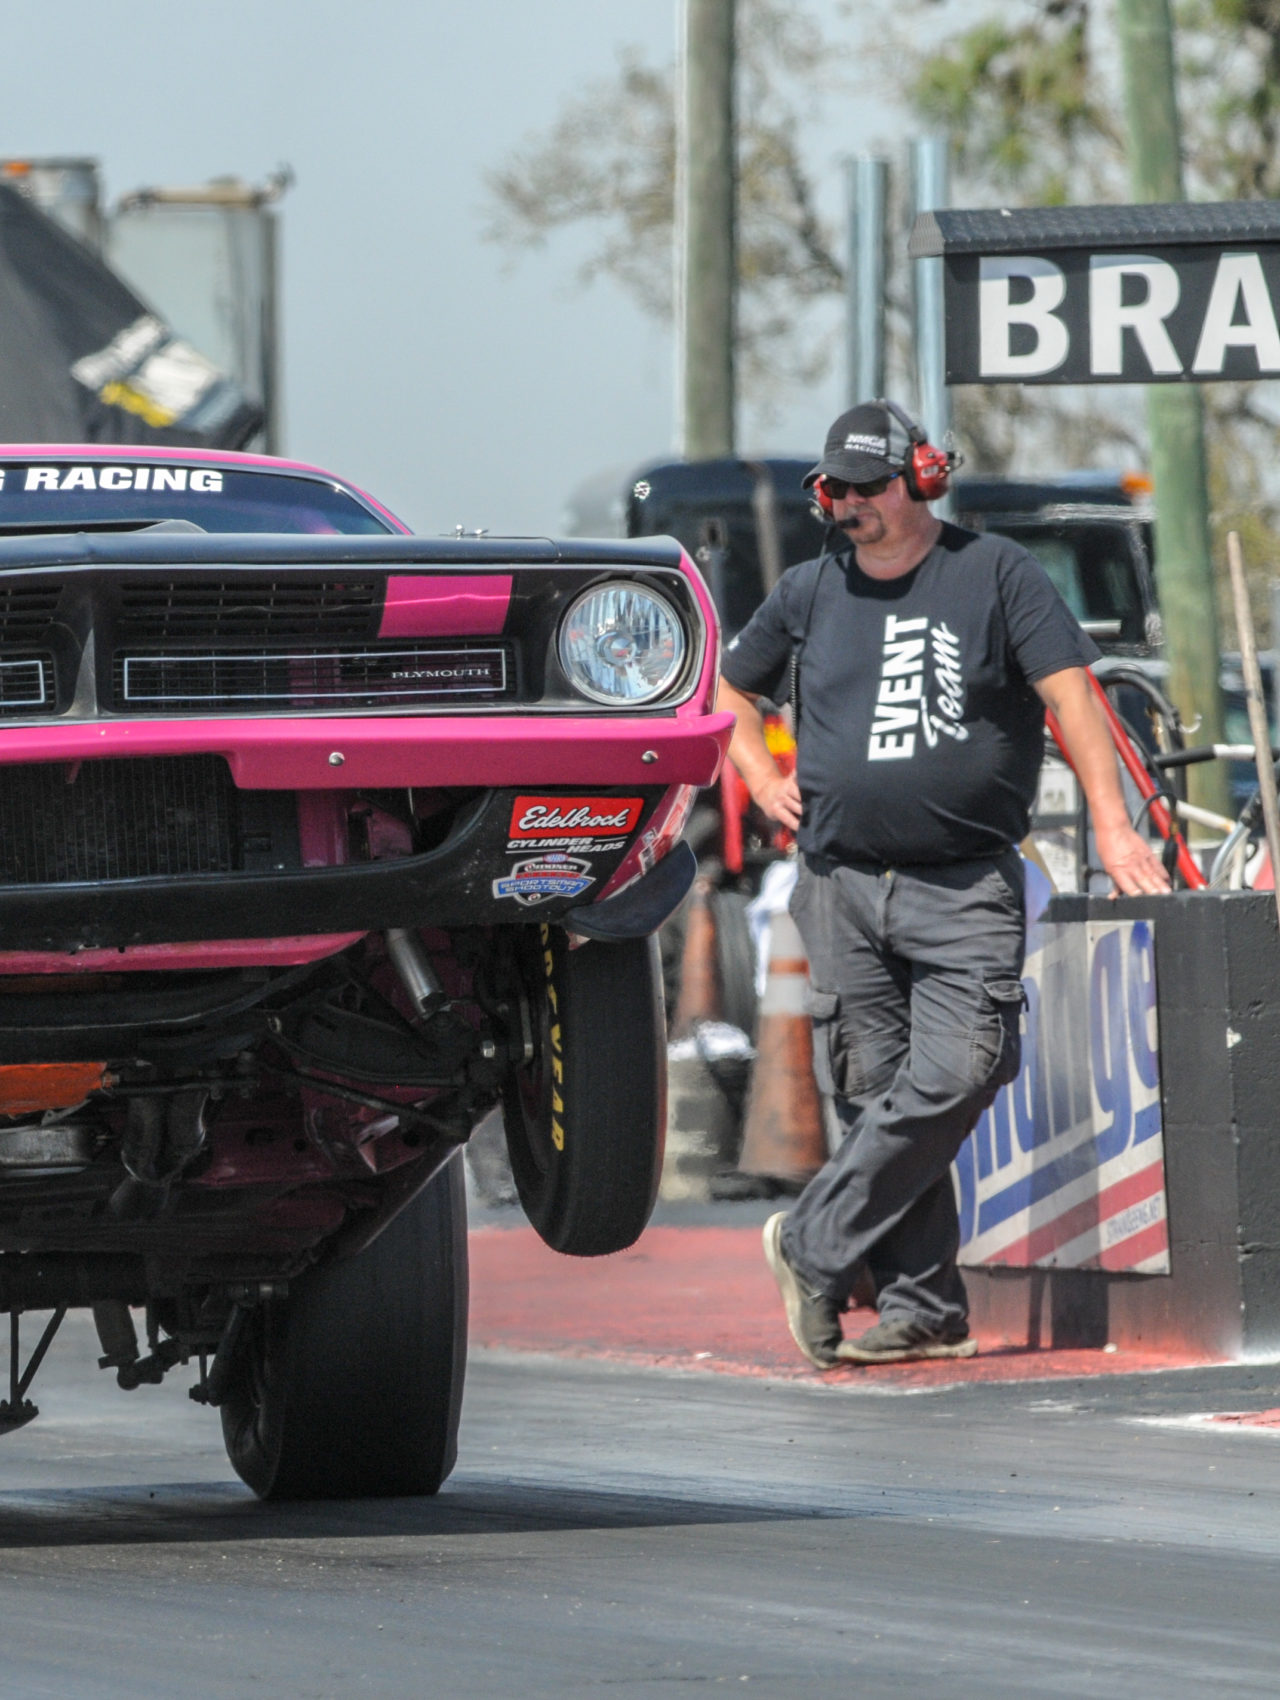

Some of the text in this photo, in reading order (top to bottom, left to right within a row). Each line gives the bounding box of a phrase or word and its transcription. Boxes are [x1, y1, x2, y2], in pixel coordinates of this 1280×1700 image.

[979, 252, 1280, 377] BRA
[24, 467, 224, 492] RACING
[391, 668, 490, 679] PLYMOUTH
[920, 621, 969, 749] Team
[868, 614, 929, 761] EVENT
[518, 805, 630, 830] Edelbrock
[506, 837, 594, 849] CYLINDER
[565, 841, 626, 854] HEADS
